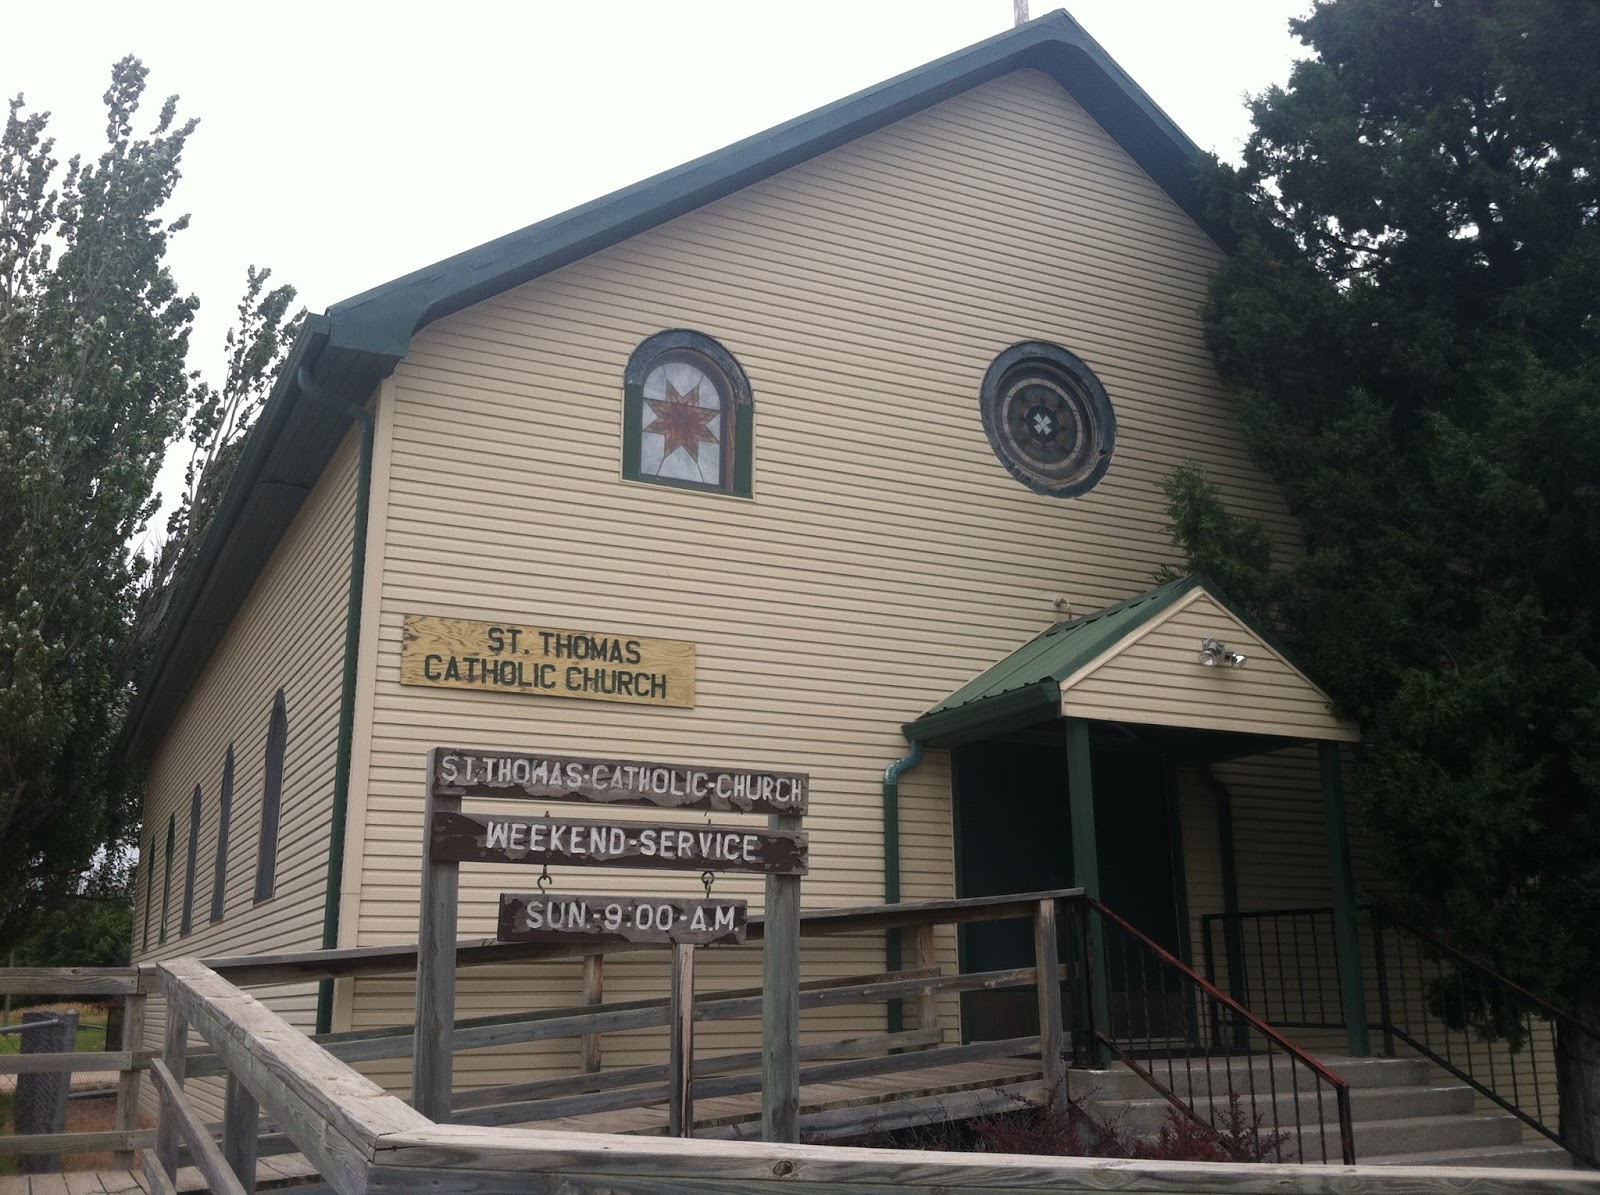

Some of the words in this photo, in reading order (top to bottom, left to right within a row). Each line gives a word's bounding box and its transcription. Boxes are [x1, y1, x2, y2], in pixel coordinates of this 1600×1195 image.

[487, 627, 530, 654] ST.
[538, 631, 641, 665] THOMAS
[424, 654, 556, 689] CATHOLIC
[565, 666, 667, 699] CHURCH
